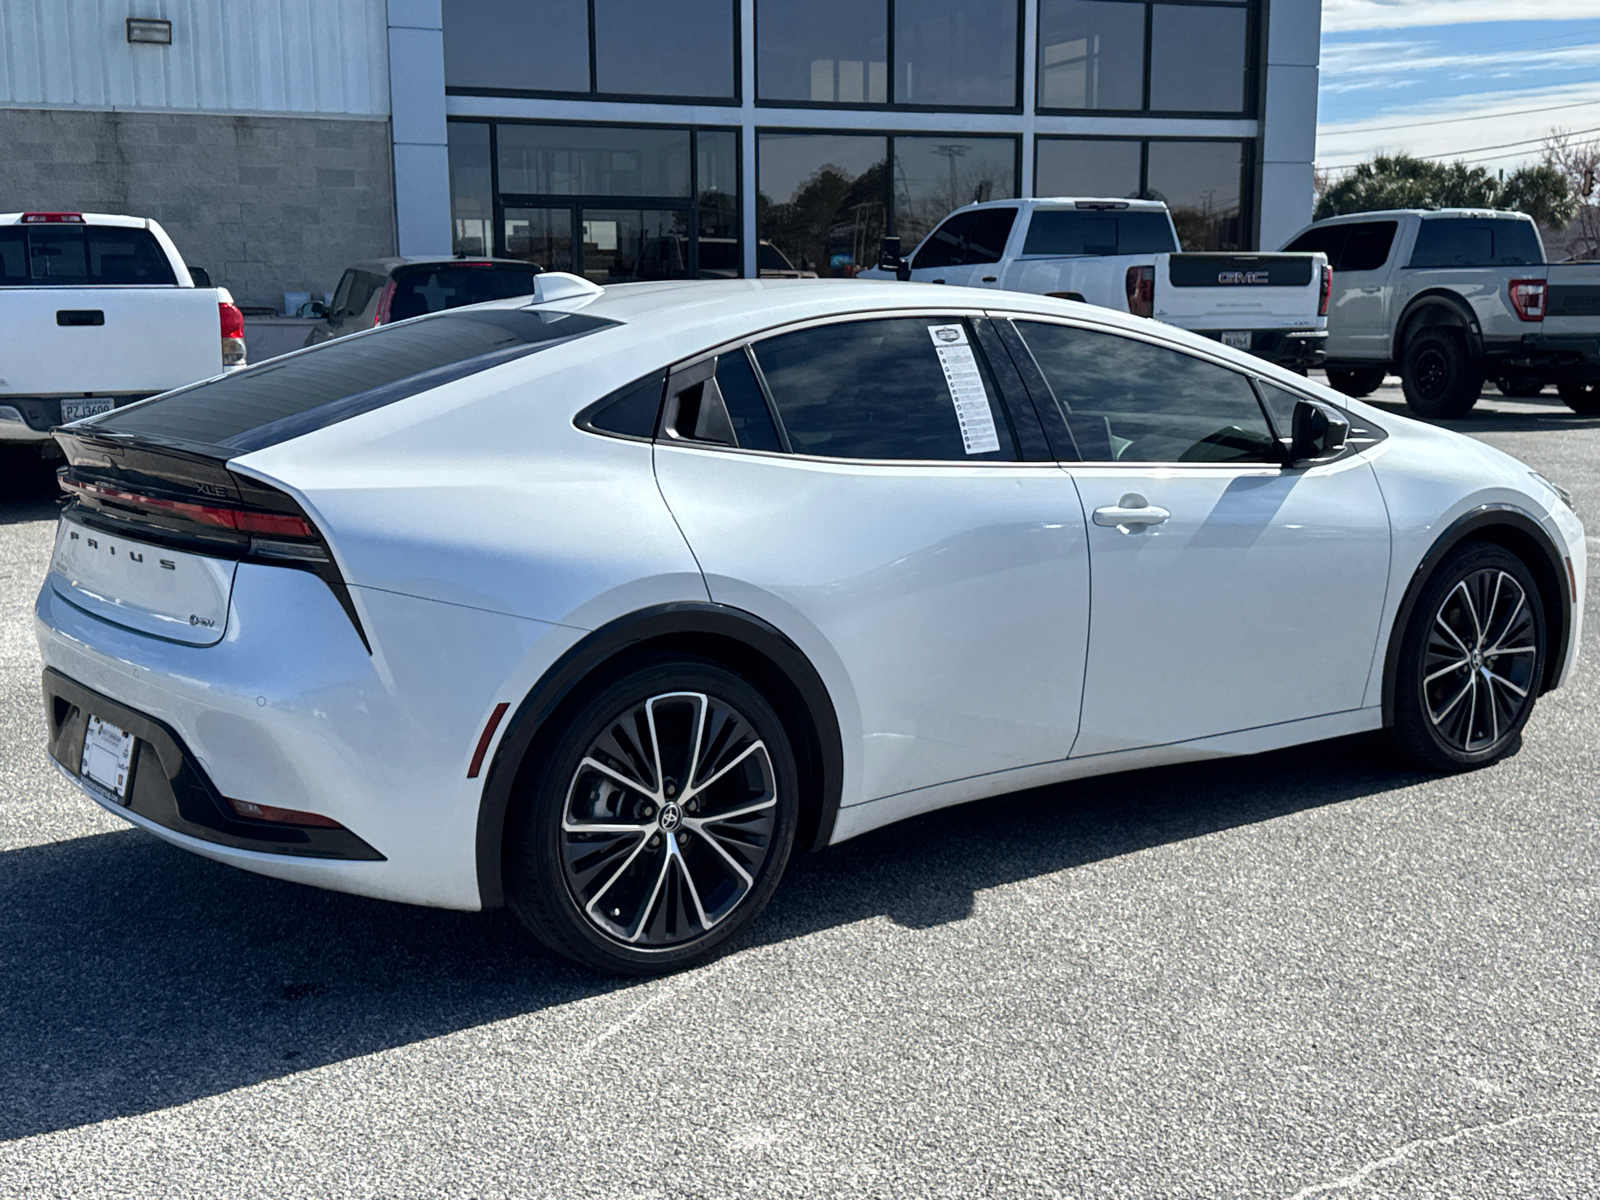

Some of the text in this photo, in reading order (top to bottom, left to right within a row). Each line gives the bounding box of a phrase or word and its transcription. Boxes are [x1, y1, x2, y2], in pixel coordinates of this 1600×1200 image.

[1218, 271, 1269, 283] GMC
[195, 482, 227, 497] XLE
[70, 531, 176, 571] PRIUS
